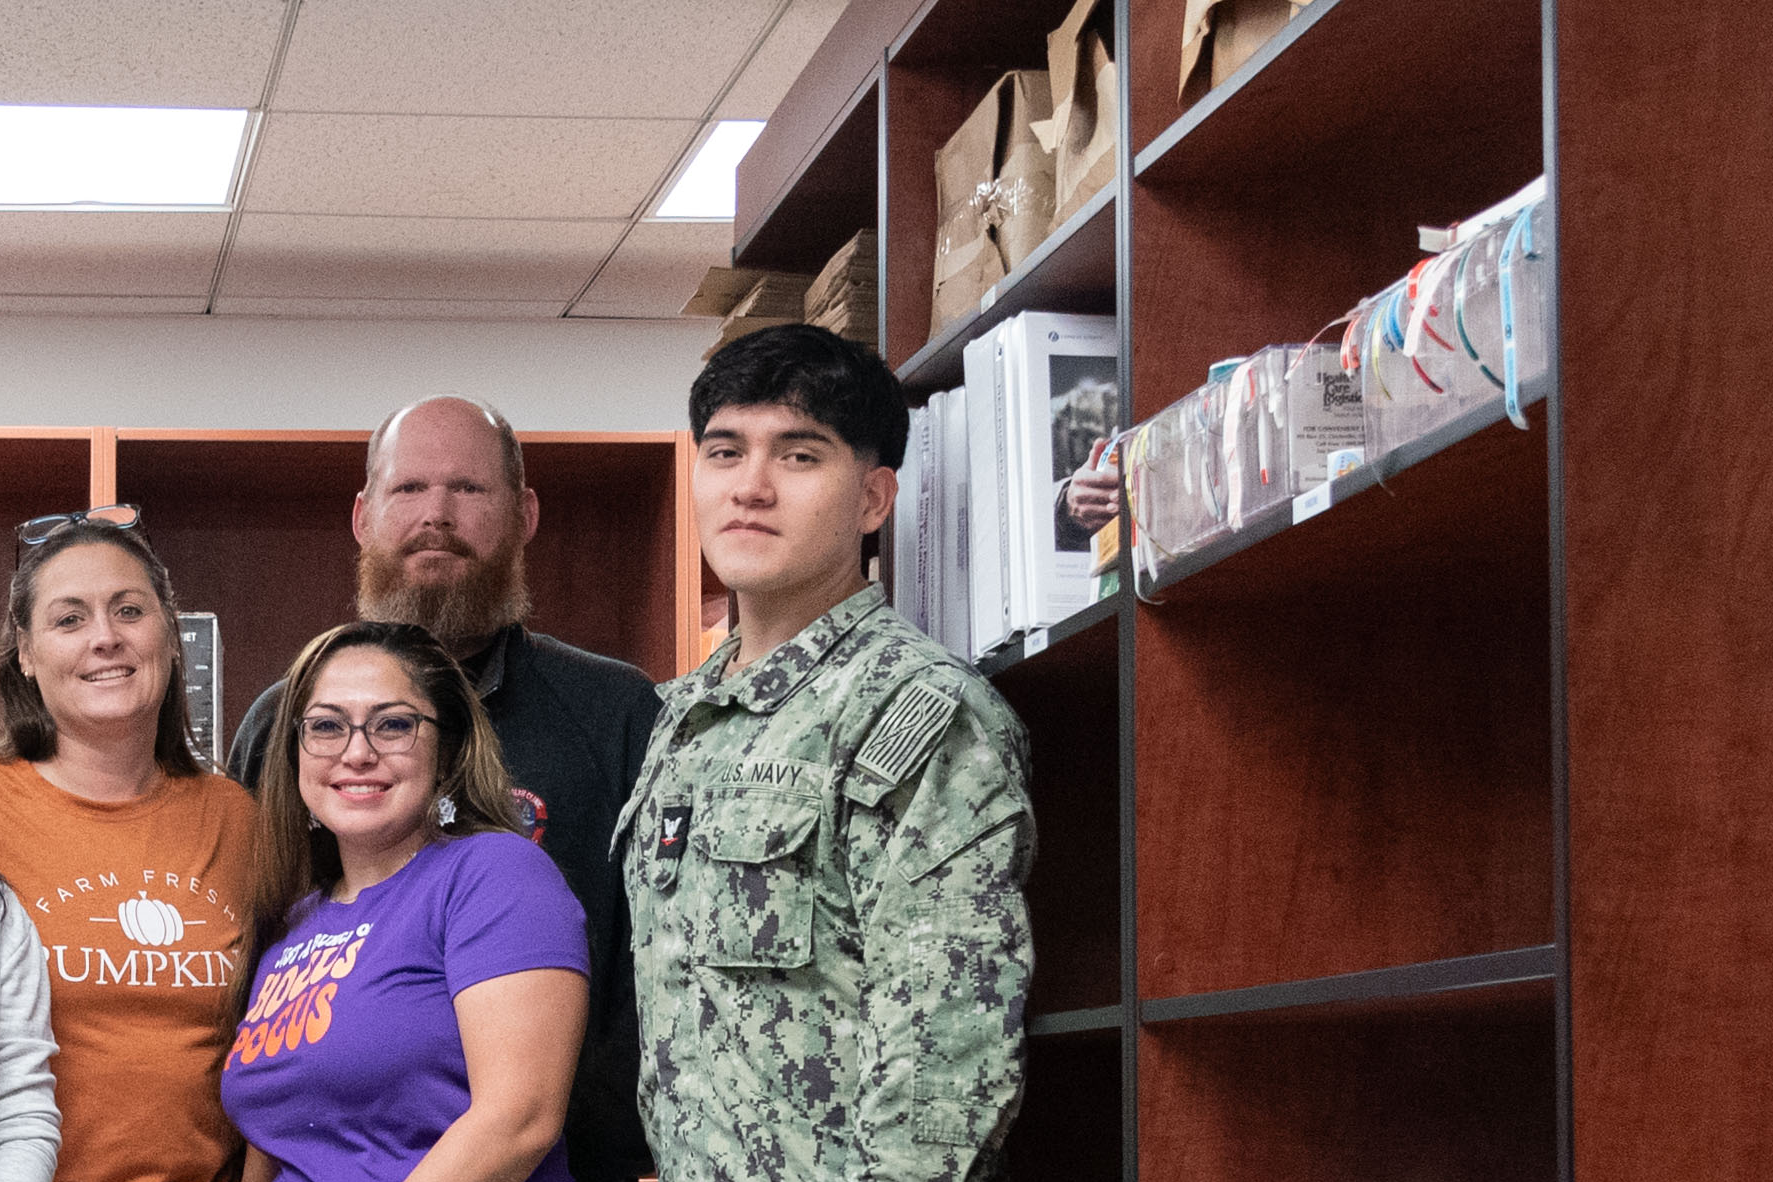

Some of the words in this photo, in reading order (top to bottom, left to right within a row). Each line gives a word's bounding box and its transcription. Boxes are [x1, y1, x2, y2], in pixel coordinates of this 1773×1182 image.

[721, 763, 743, 783] U.S.
[750, 763, 803, 787] NAVY
[35, 872, 120, 914] FARM
[41, 945, 239, 988] UMPKIN
[245, 937, 366, 1024] HOCUS
[224, 981, 339, 1071] POCUS
